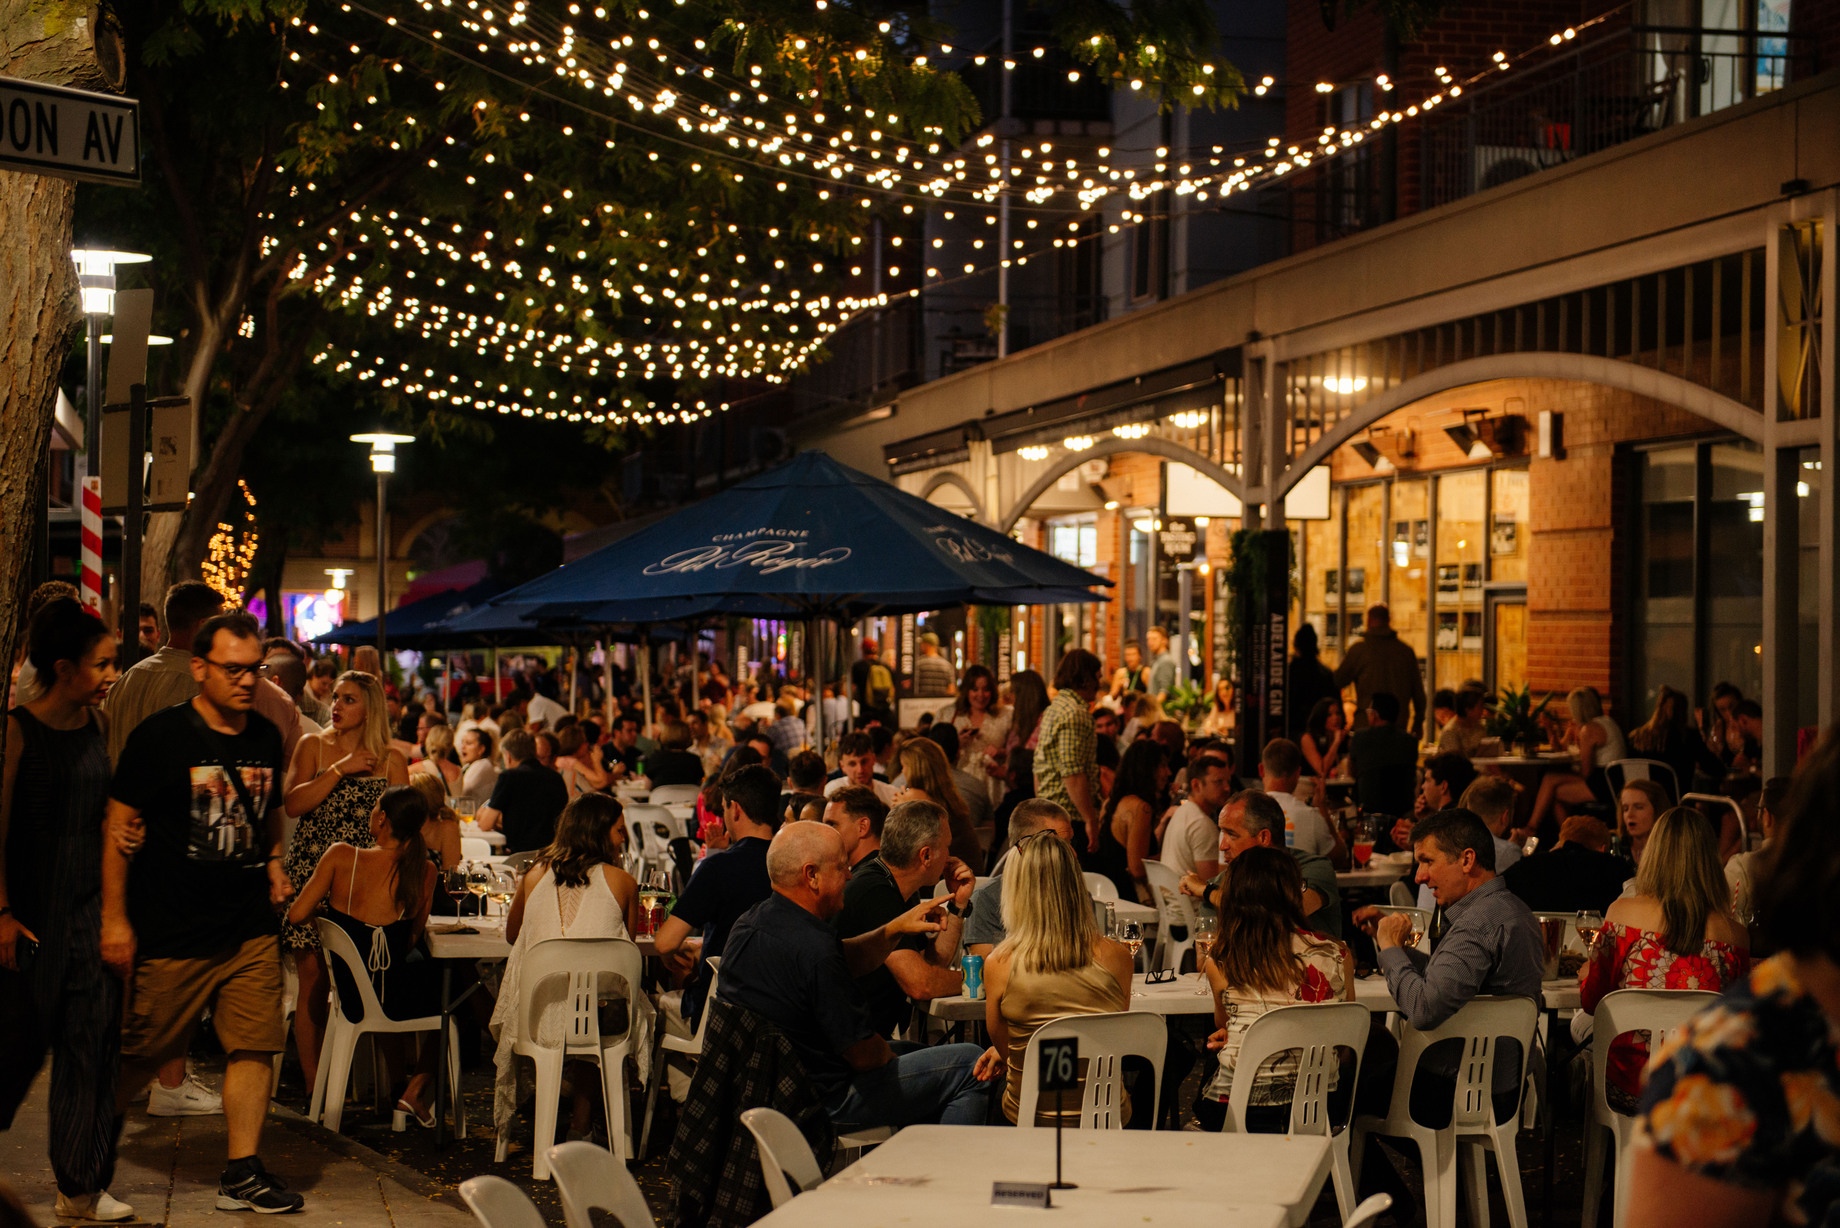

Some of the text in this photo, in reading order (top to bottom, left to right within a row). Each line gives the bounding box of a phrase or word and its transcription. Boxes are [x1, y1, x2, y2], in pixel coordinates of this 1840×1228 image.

[0, 98, 123, 164] ON AV
[712, 527, 809, 542] CHAMPAGNE
[715, 540, 852, 575] Roger
[1269, 612, 1285, 716] ADELAIDE GIN
[1044, 1045, 1072, 1082] 76
[994, 1189, 1044, 1199] RESERVED
